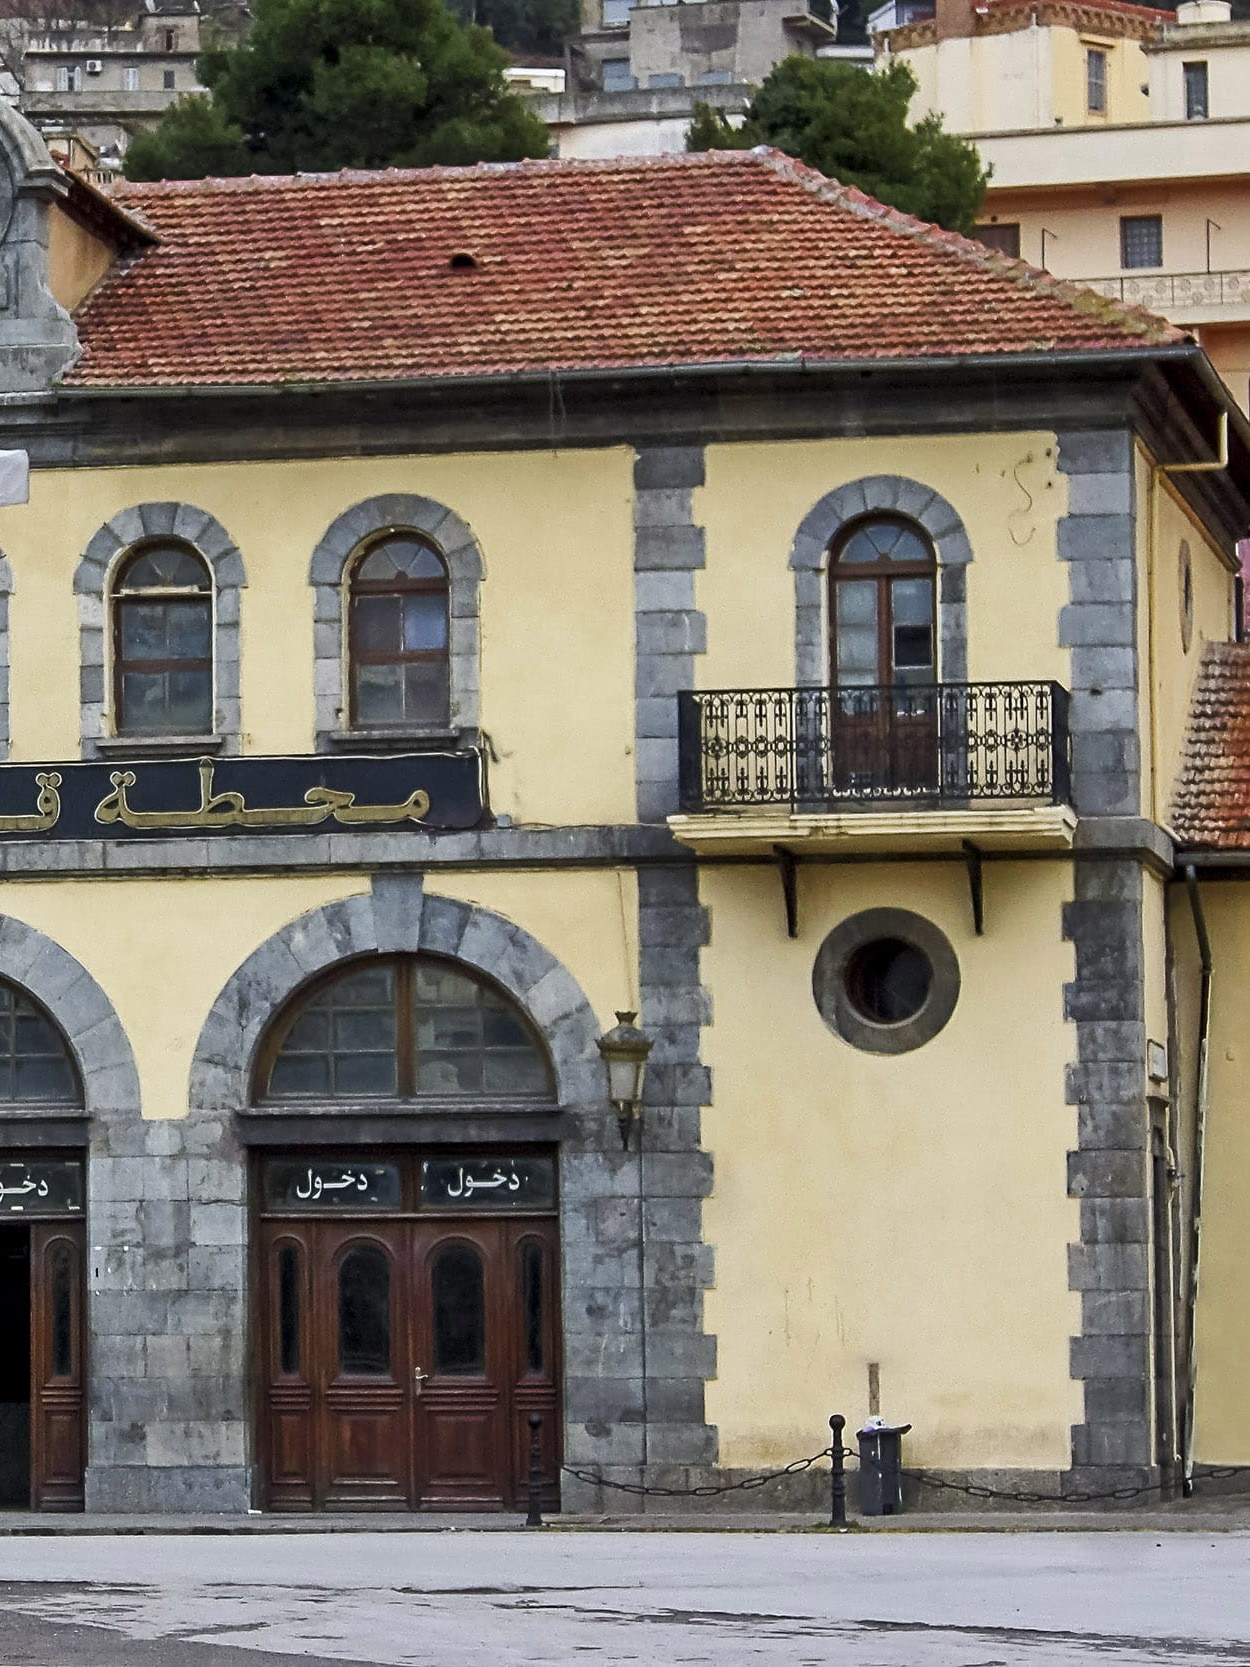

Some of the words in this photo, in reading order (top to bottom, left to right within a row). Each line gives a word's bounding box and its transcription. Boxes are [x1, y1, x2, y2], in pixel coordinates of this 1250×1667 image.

[94, 758, 430, 830] محطة
[296, 1169, 368, 1199] دخول
[447, 1167, 520, 1197] دخول
